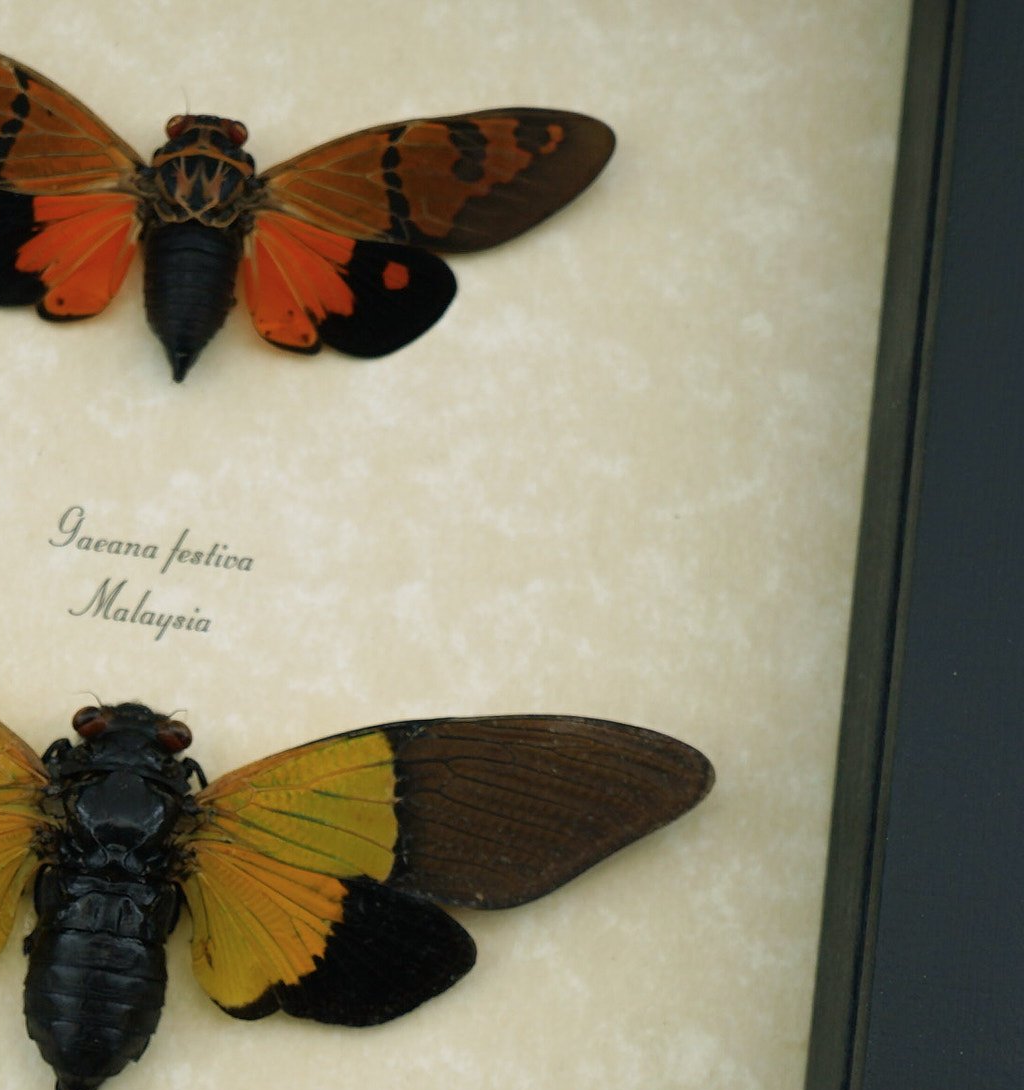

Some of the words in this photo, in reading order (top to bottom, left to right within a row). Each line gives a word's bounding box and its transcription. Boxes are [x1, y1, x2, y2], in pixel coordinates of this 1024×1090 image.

[48, 505, 159, 560] Gaeana
[160, 528, 254, 574] festiva
[68, 577, 211, 641] Malaysia
